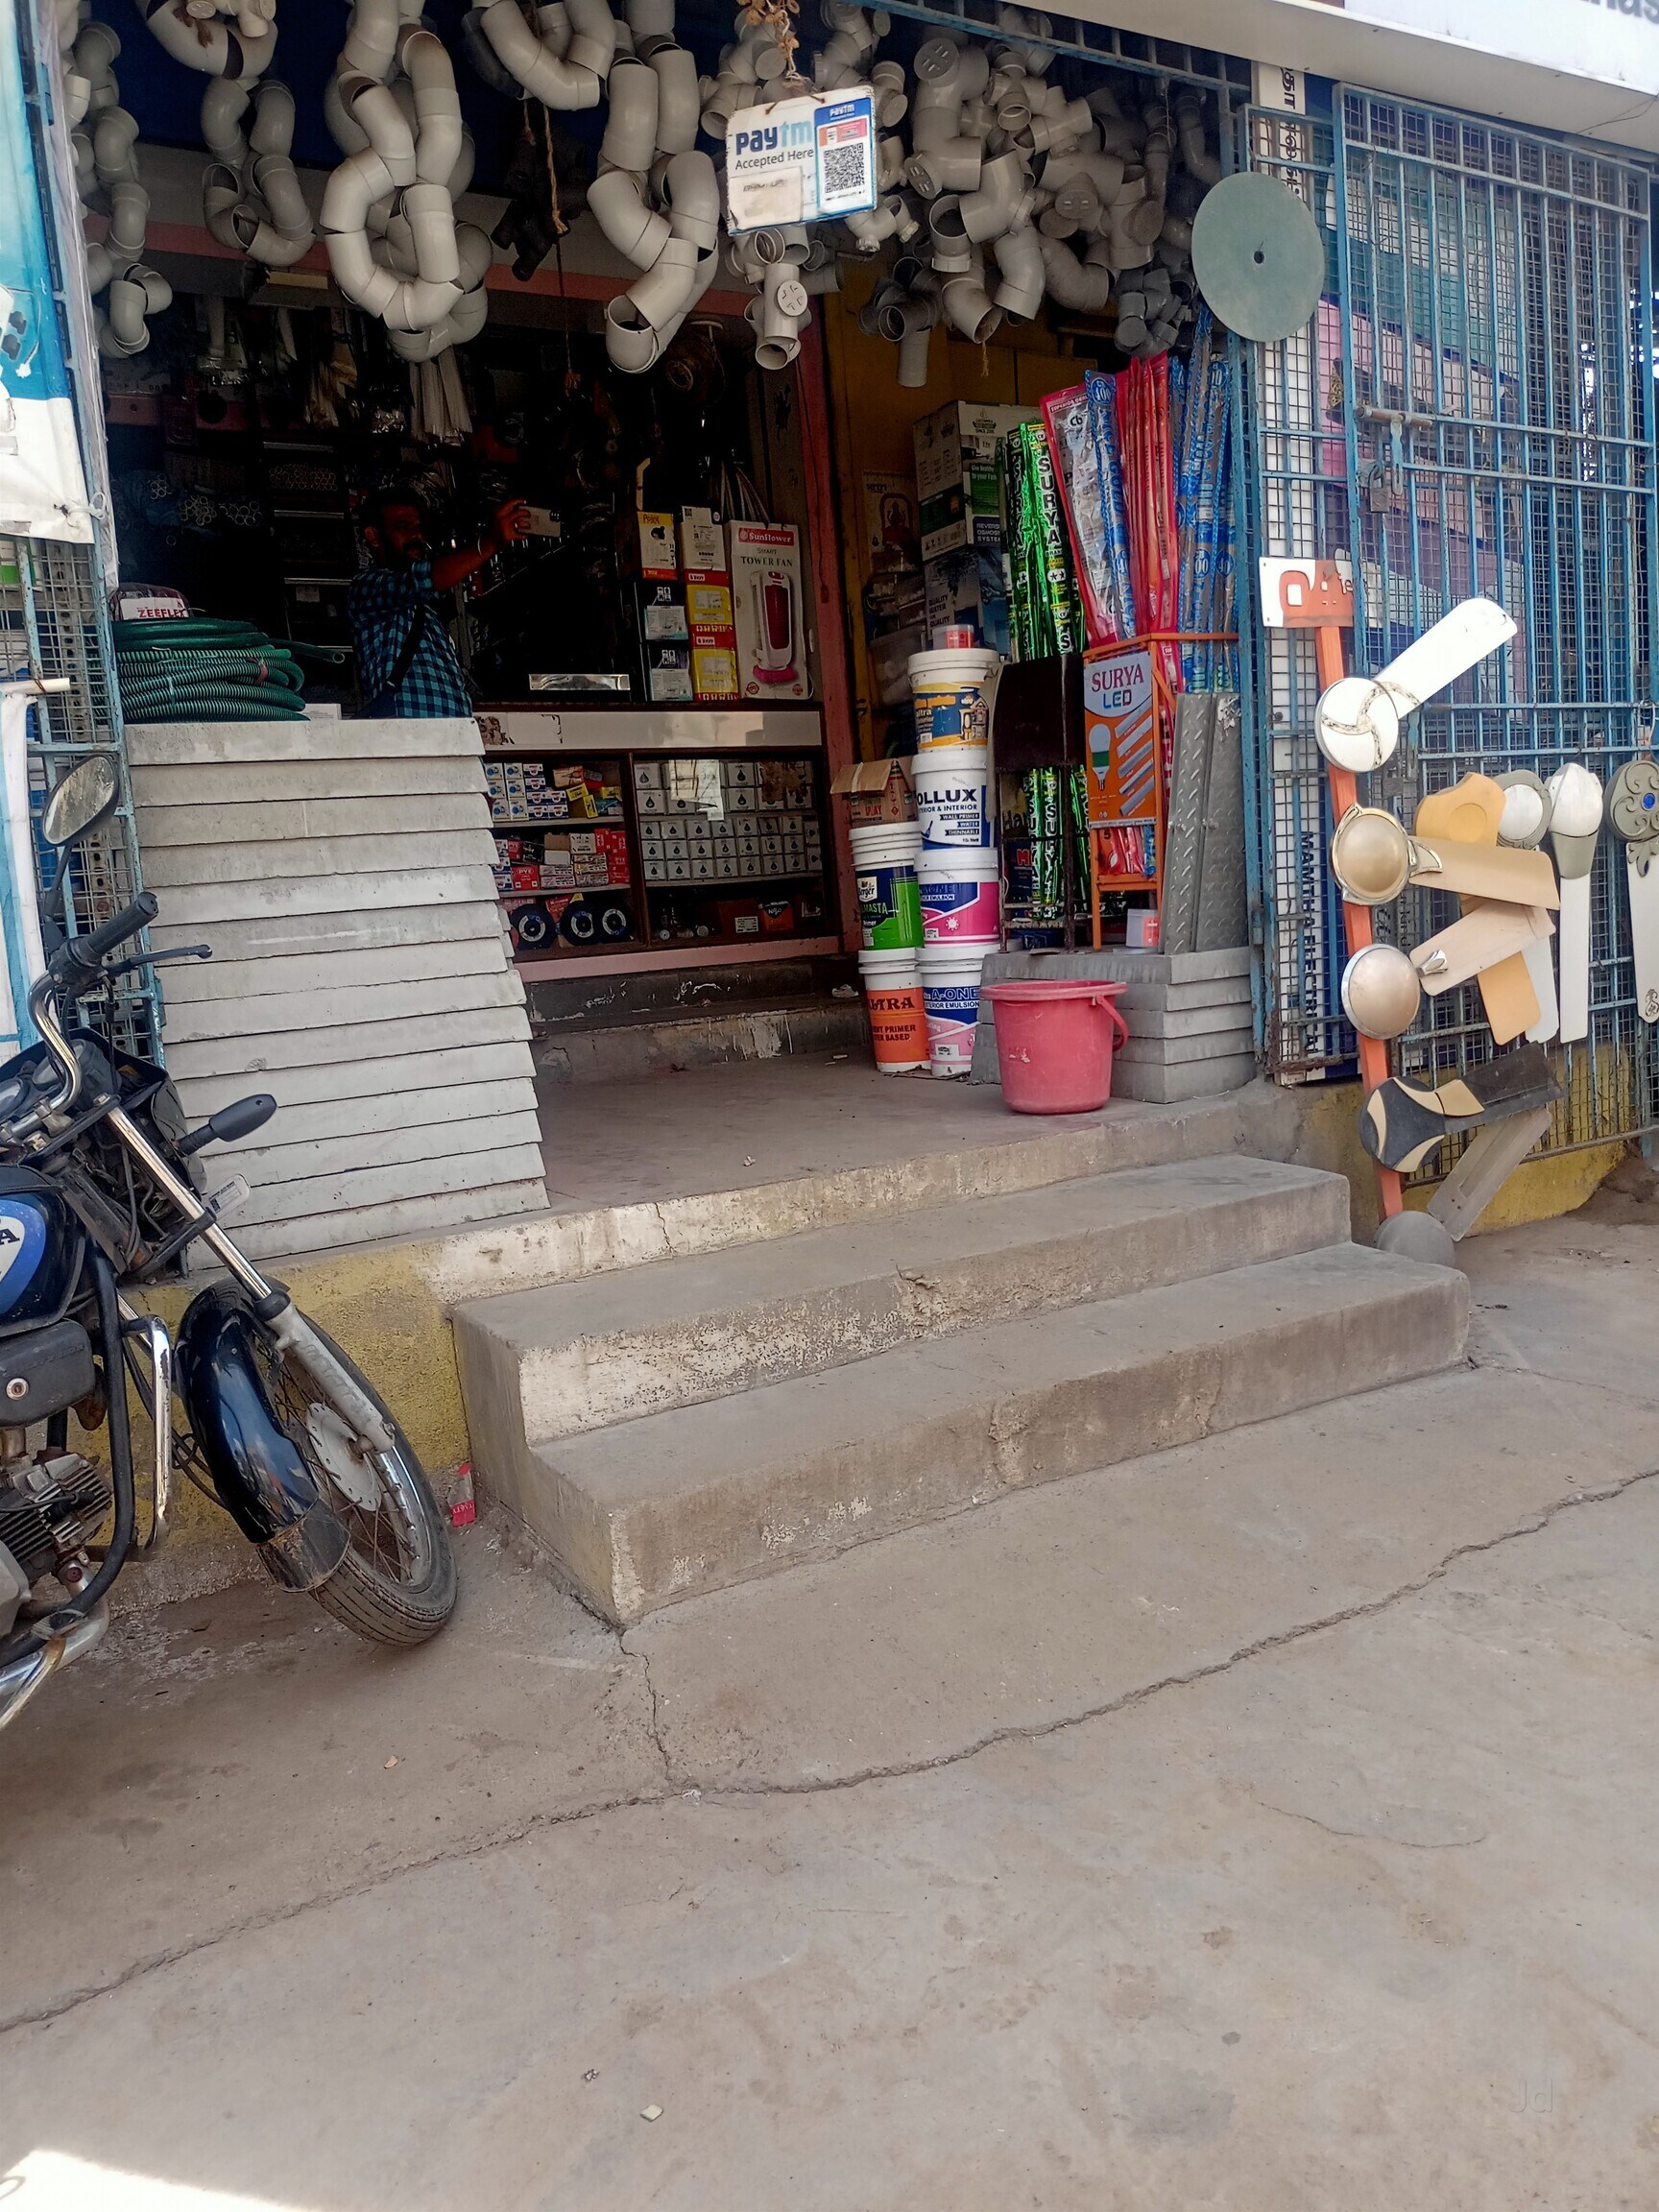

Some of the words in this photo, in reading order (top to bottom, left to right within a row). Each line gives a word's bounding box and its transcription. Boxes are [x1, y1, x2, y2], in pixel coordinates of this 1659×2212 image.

[735, 152, 784, 170] Accepted
[787, 149, 814, 161] Here
[749, 532, 791, 542] Sunflower
[740, 556, 774, 565] TOWER
[776, 558, 793, 566] FAN
[1092, 662, 1145, 693] SURYA
[1103, 688, 1133, 709] LED
[917, 788, 977, 806] OLLUX
[944, 804, 977, 812] INTERIOR
[945, 1000, 979, 1009] EMULSION
[885, 1024, 916, 1033] PRIMER
